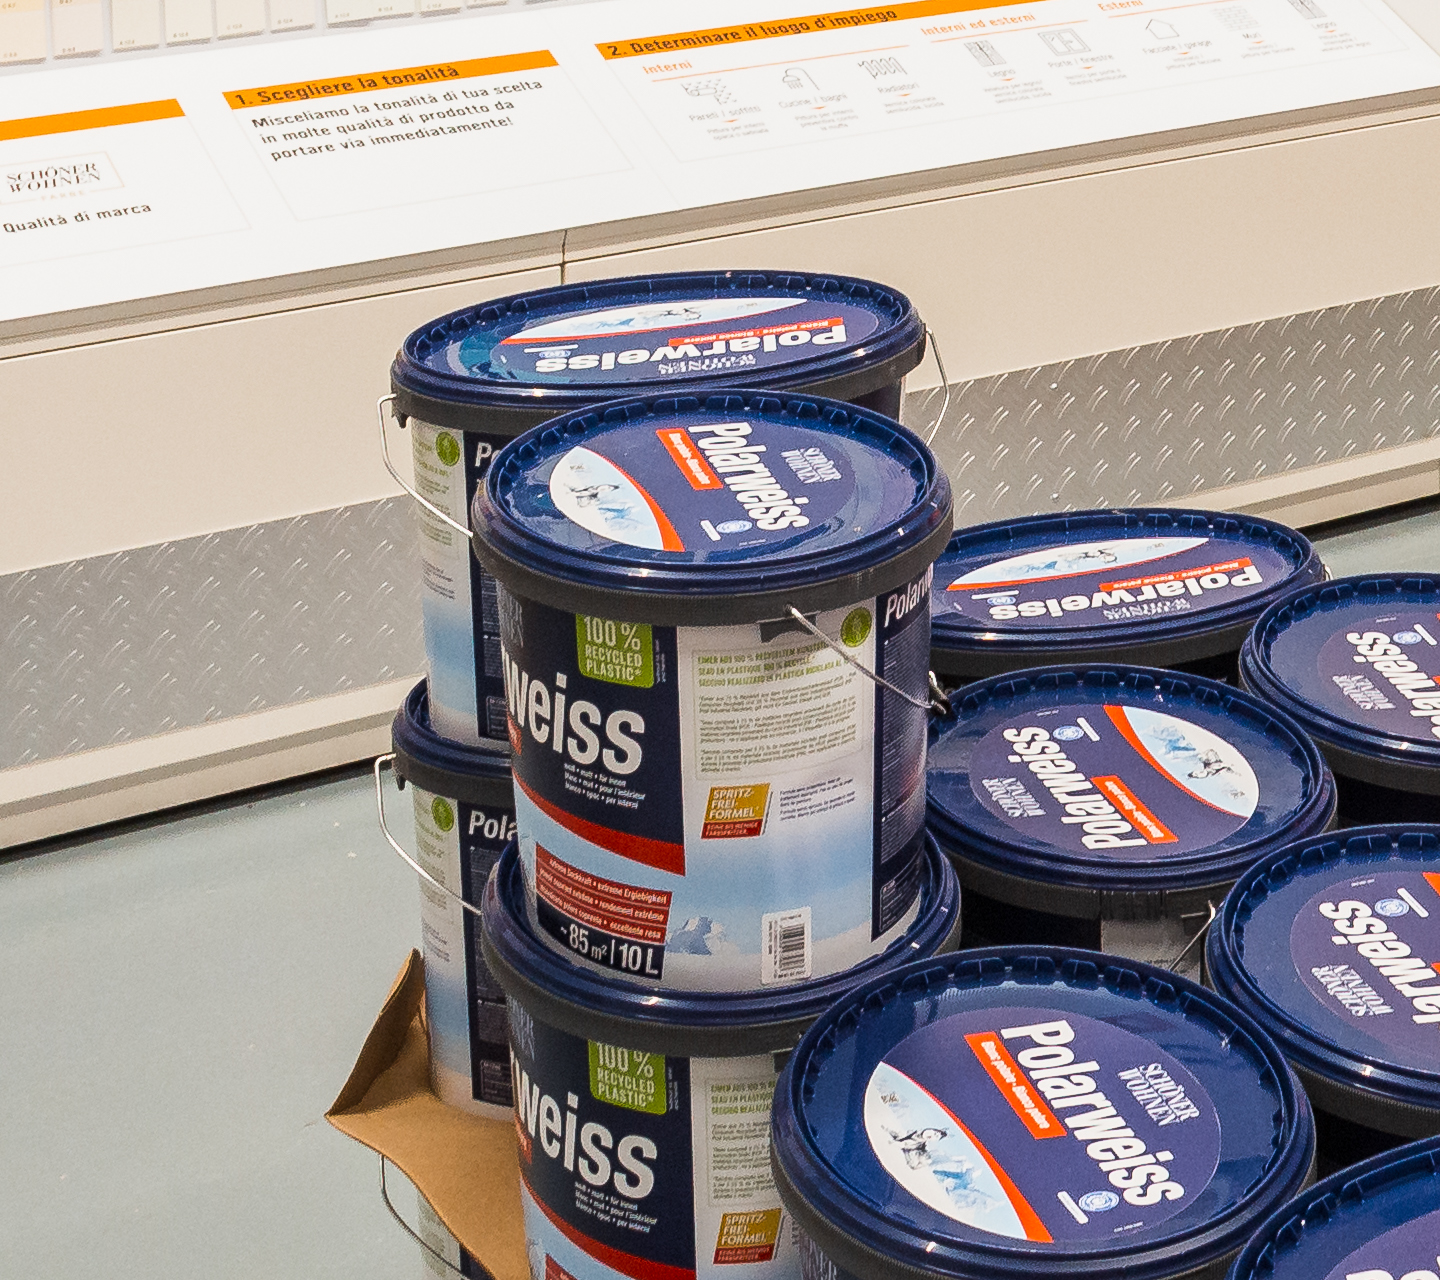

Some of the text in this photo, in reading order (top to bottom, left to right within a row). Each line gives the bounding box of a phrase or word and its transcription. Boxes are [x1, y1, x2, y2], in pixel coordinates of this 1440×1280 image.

[606, 8, 898, 57] 2. Determinare il luogo d'impiego
[920, 11, 1037, 37] Interni ed esterni
[641, 59, 694, 76] Interni
[235, 65, 460, 106] 1. Scegliere la tonalità
[251, 79, 543, 129] Misceliamo la tonalità di tua scelta
[259, 100, 515, 145] in molte qualità di prodotto da
[270, 116, 514, 161] portare via immediatamente!
[6, 163, 97, 182] SCHÖNER
[10, 171, 101, 193] WOHNEN
[3, 204, 151, 233] Qualità di marca
